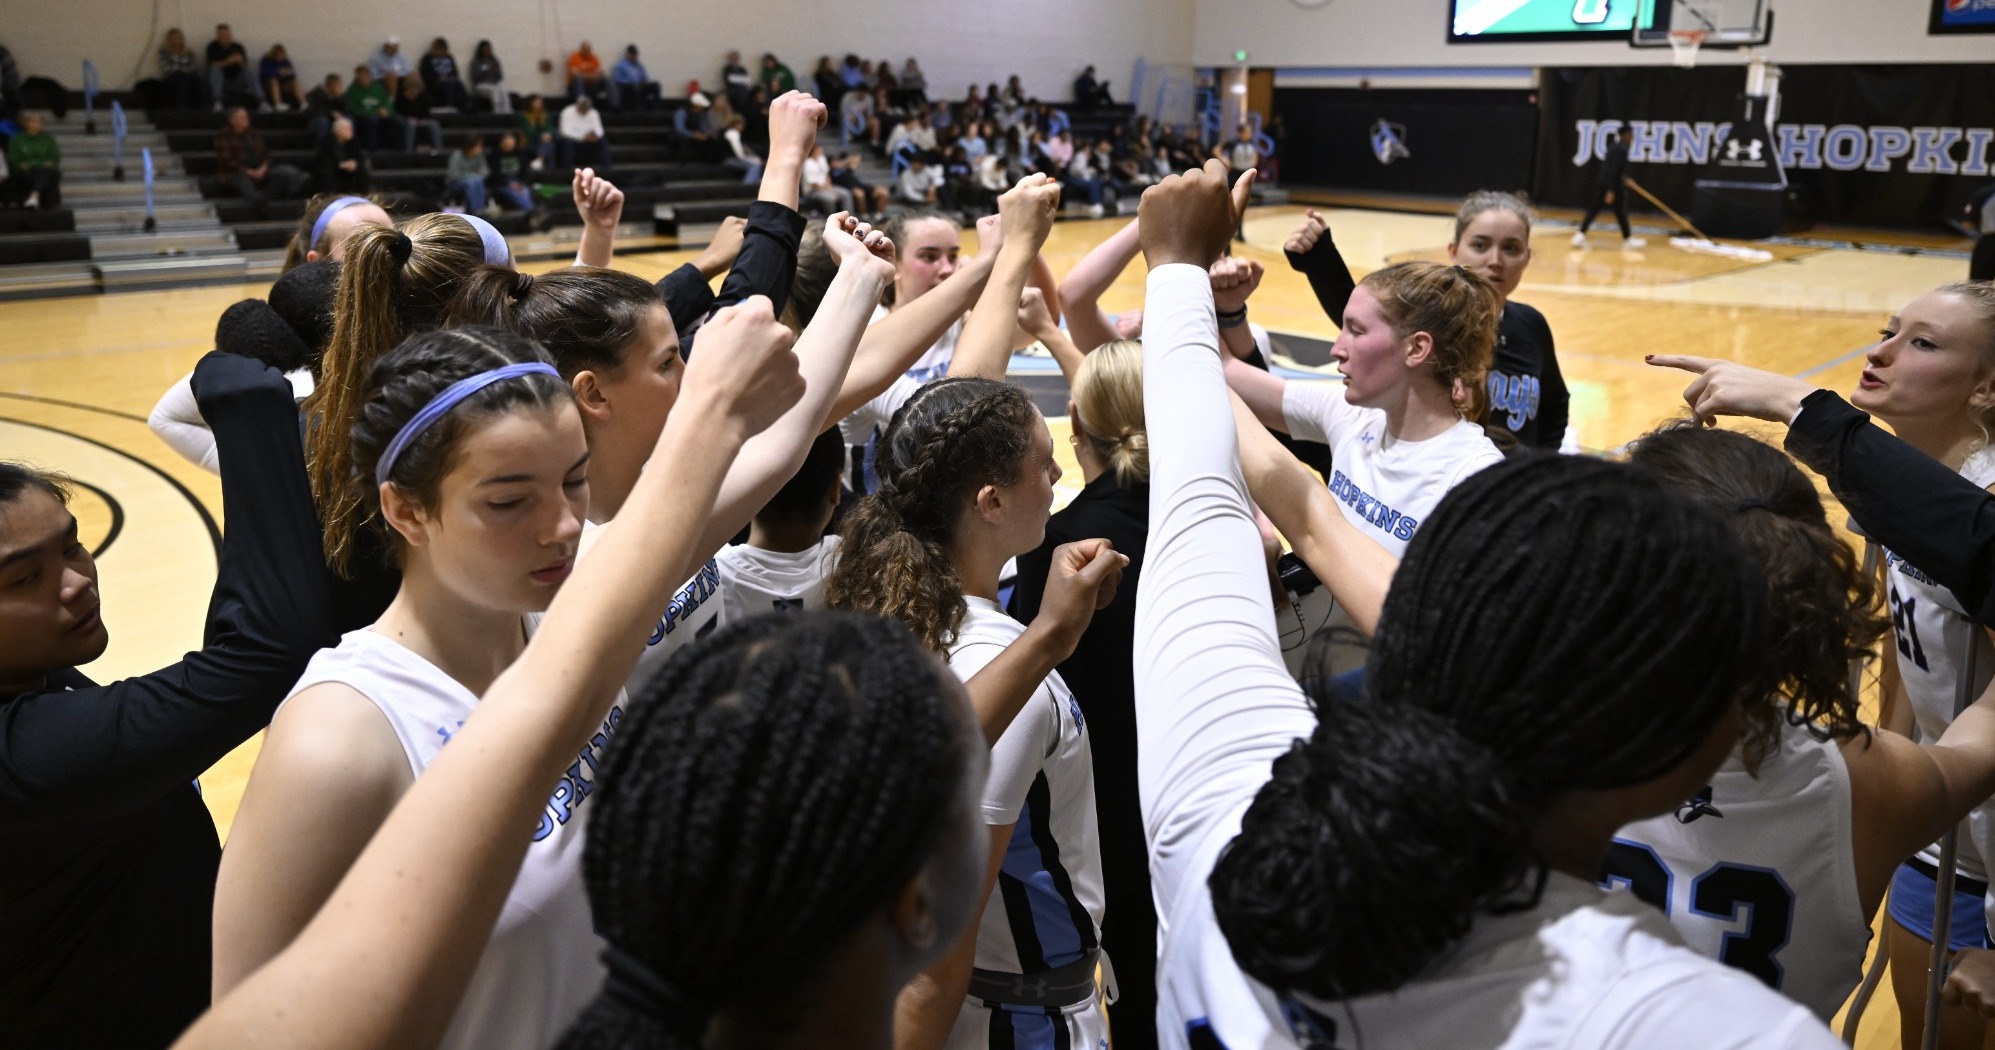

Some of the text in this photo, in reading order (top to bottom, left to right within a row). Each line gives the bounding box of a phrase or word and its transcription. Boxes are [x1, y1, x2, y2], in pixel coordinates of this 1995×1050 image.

[1777, 124, 1995, 176] HOPKI
[1329, 469, 1418, 541] HOPKINS
[1890, 584, 1930, 673] 21
